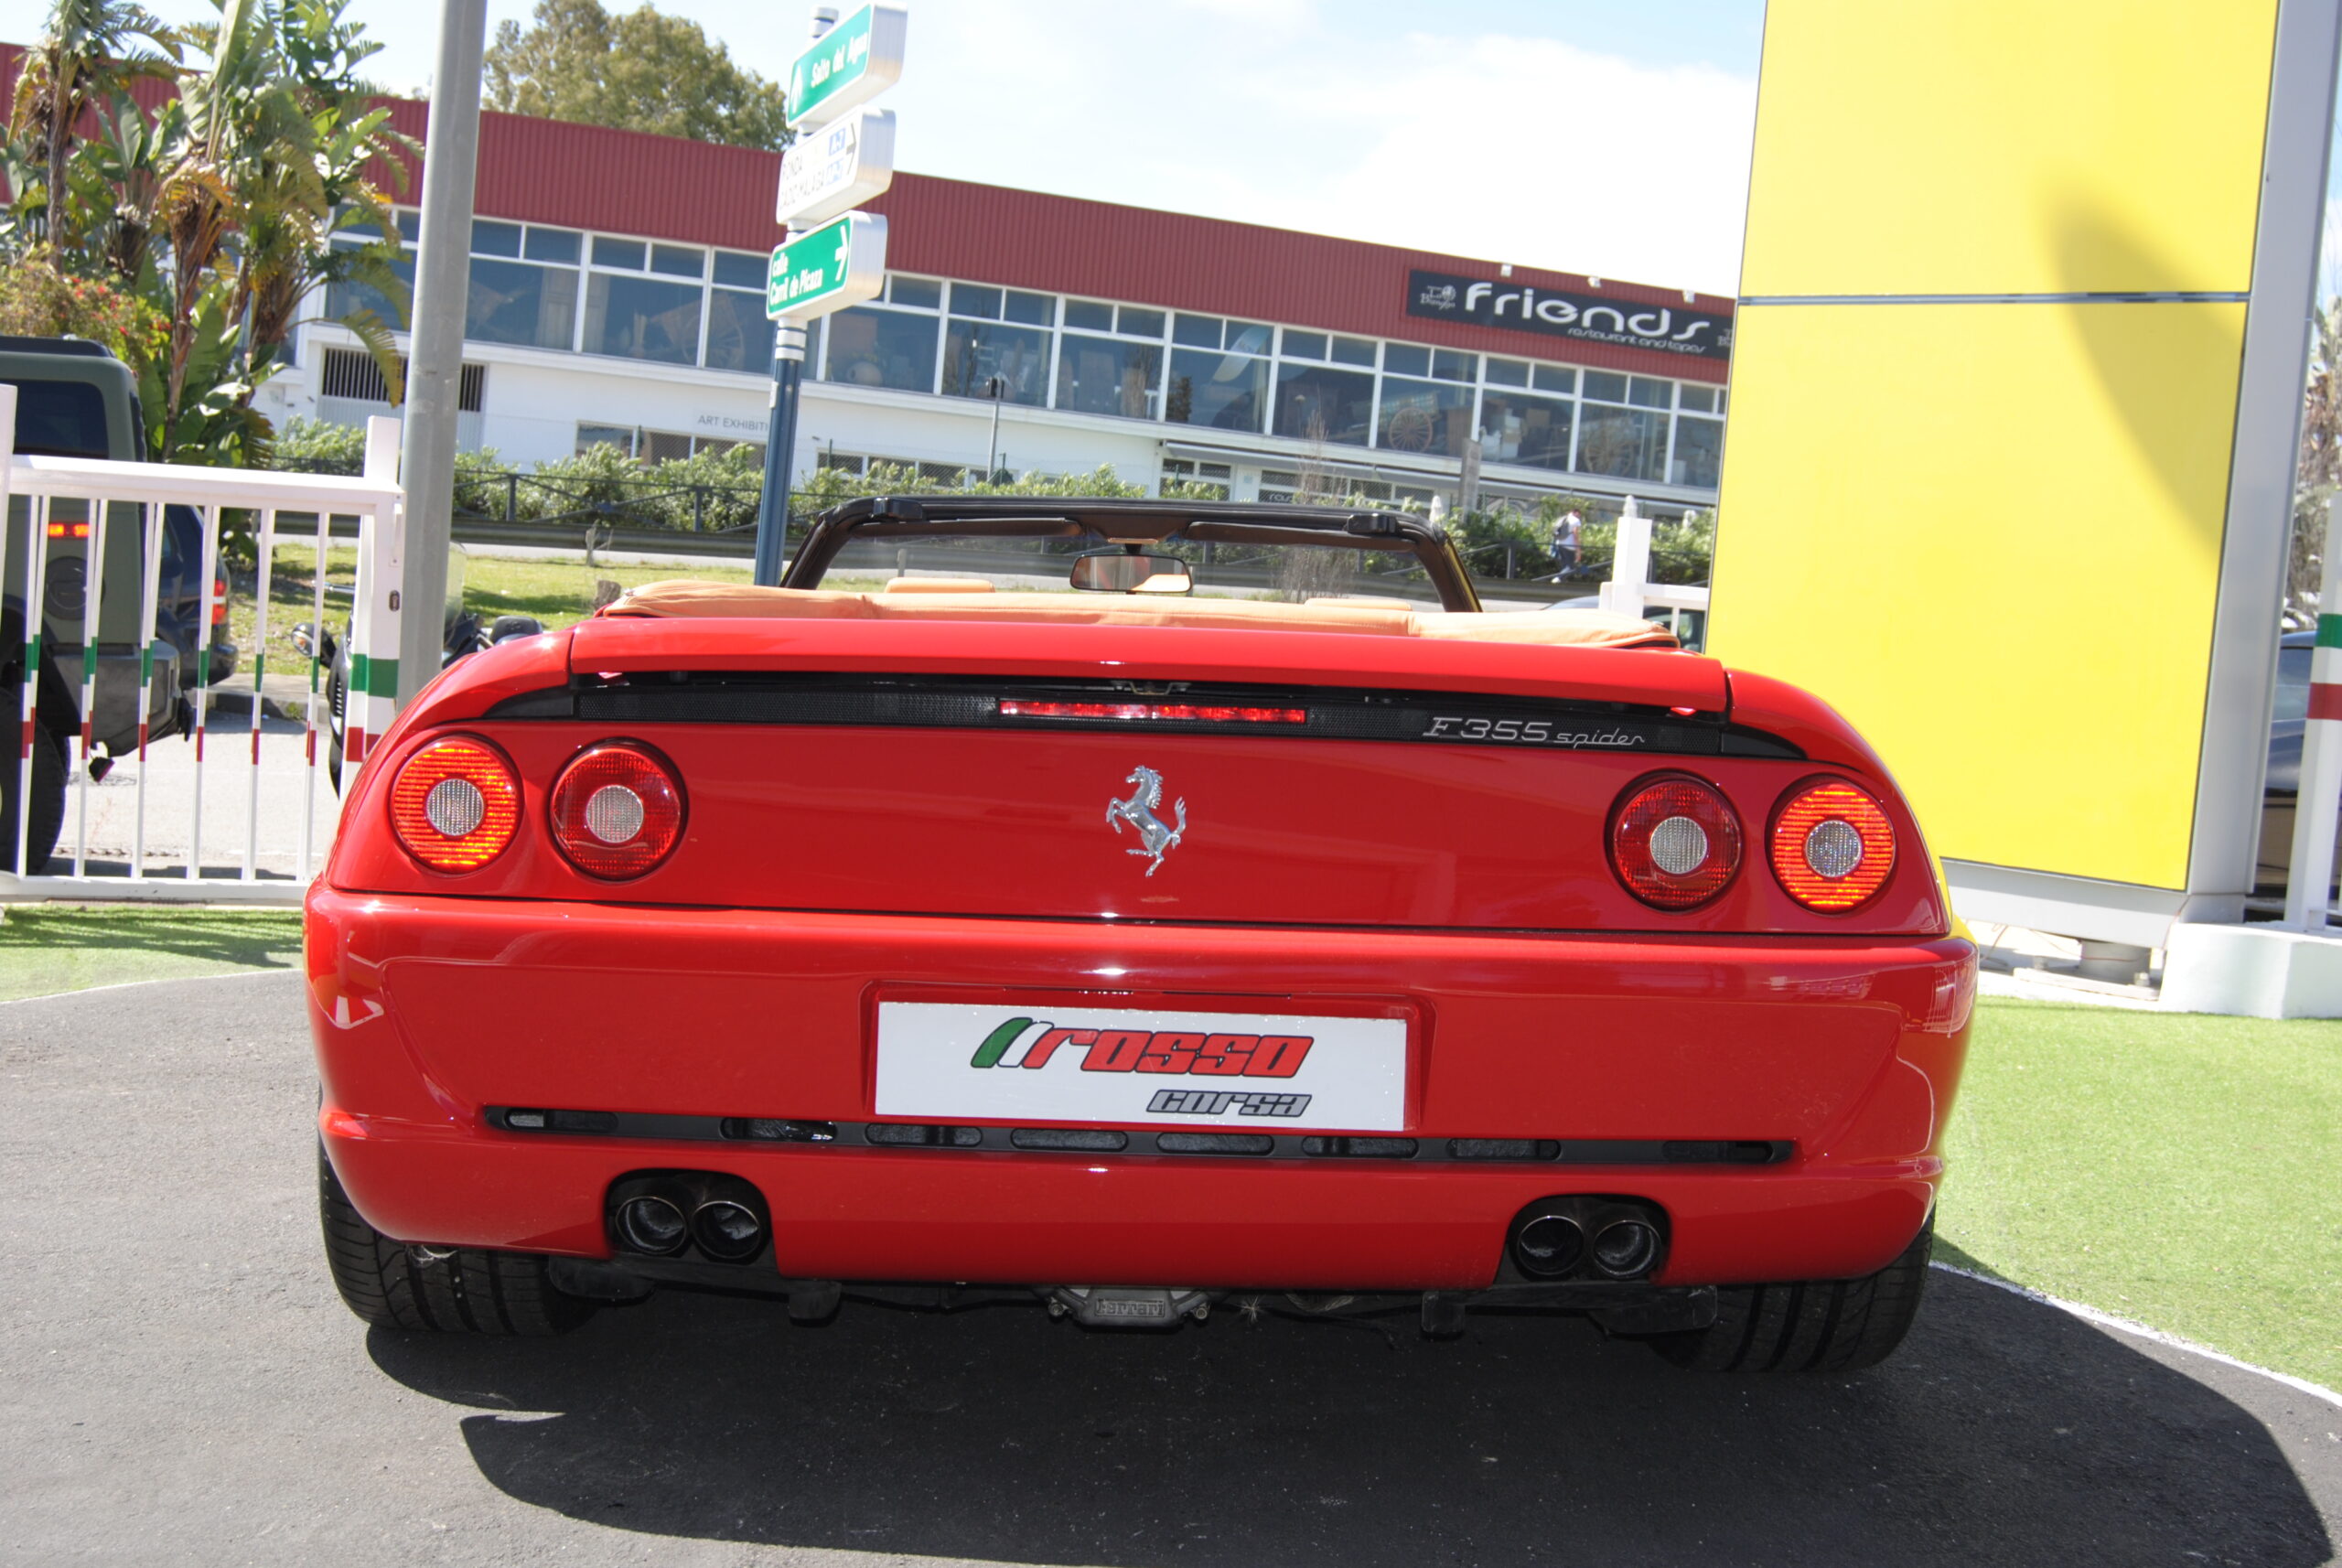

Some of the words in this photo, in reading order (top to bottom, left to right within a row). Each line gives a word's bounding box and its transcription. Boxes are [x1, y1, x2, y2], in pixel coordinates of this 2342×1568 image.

[833, 43, 845, 73] del
[790, 274, 799, 298] de
[1638, 338, 1667, 349] and
[697, 414, 720, 426] ART
[723, 417, 768, 433] EXHIBITI
[1553, 728, 1645, 749] spider
[1022, 1026, 1315, 1079] rosso
[1145, 1089, 1312, 1117] corsa
